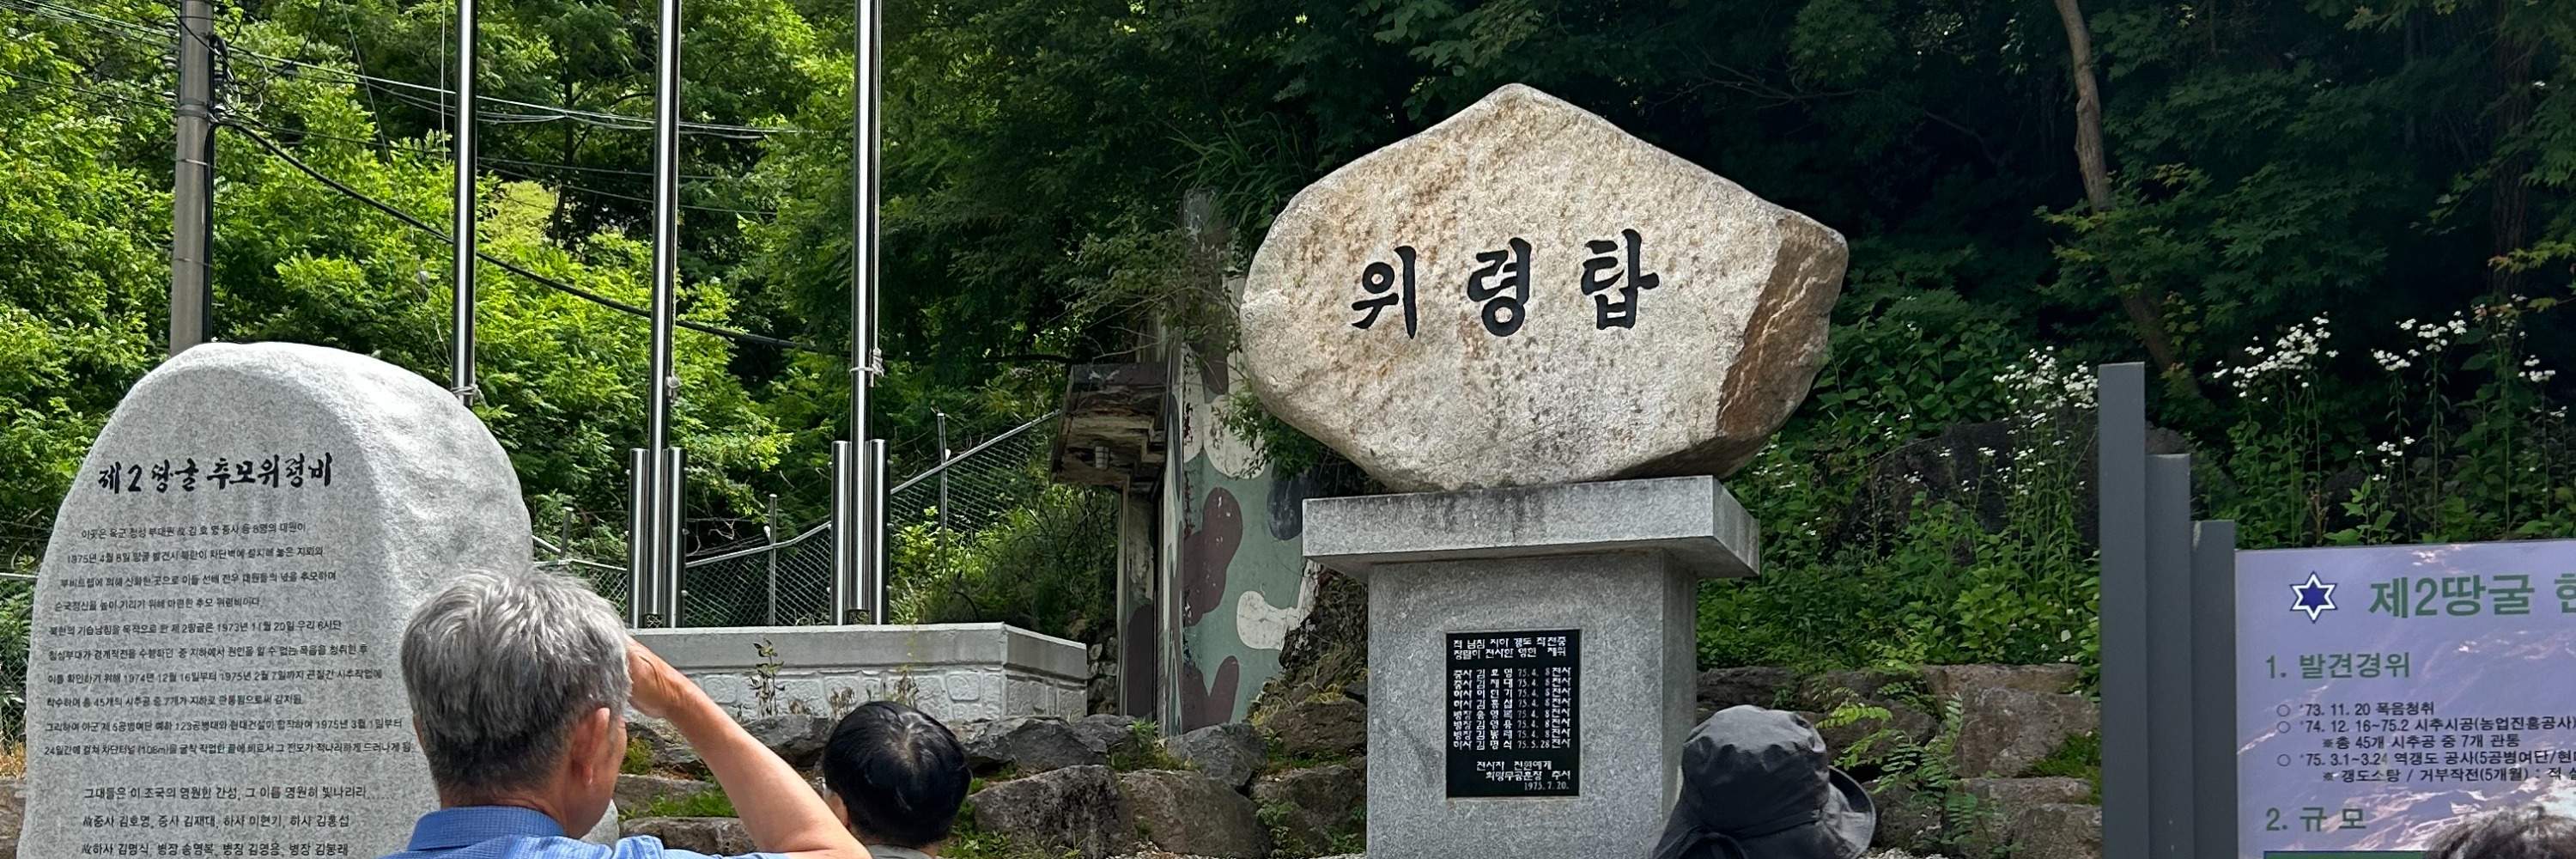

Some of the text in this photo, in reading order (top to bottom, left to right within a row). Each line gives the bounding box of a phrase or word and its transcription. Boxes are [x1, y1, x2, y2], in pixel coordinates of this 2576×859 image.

[2369, 575, 2535, 618] 제2땅굴
[217, 621, 247, 632] 1973년
[2266, 651, 2410, 679] 1. 발견경위
[2354, 703, 2371, 716] 20
[2377, 701, 2435, 716] 폭음청취
[2355, 736, 2385, 750] 45개
[2391, 735, 2436, 749] 시추공
[2441, 734, 2457, 748] 중
[2462, 734, 2484, 748] 7개
[2490, 734, 2521, 748] 관통
[2394, 752, 2439, 765] 역갱도
[2266, 807, 2288, 832] 2.
